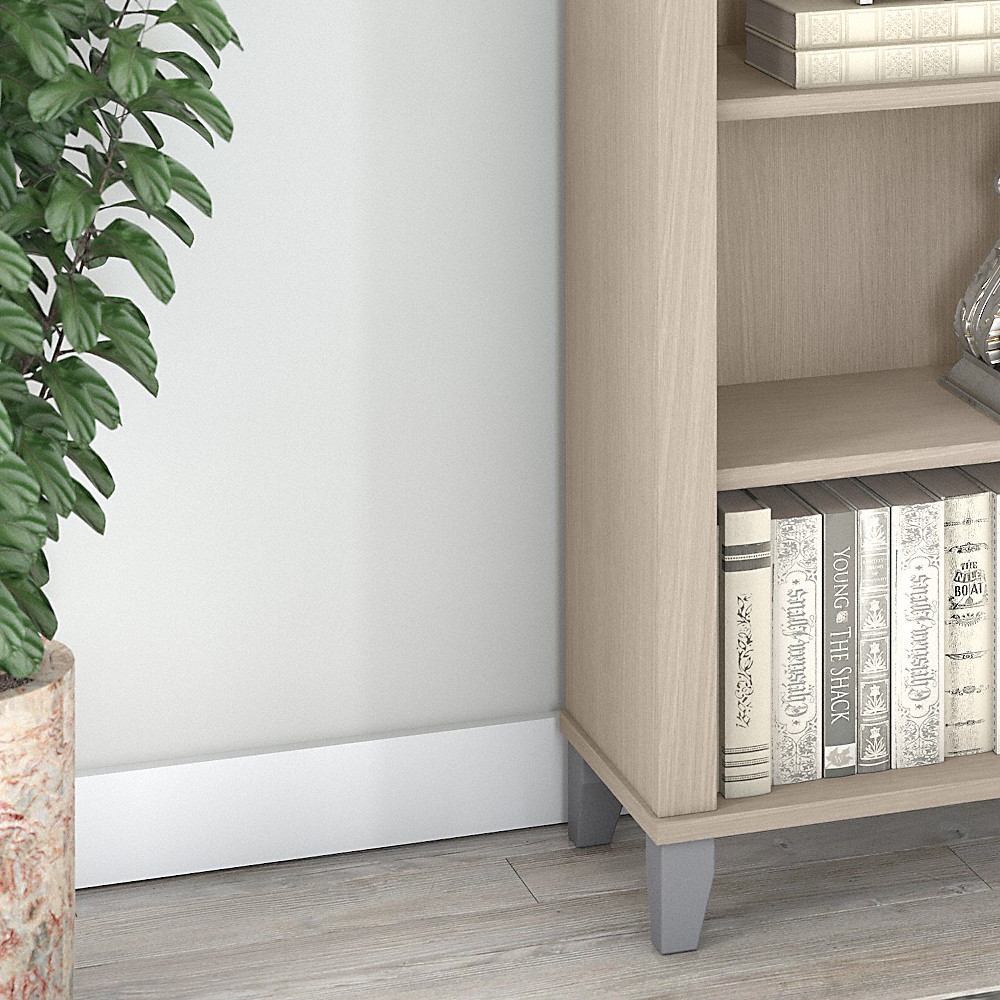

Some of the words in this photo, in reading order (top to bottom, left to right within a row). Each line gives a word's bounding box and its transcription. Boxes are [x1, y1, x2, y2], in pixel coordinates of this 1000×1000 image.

[832, 546, 851, 610] YOUNG
[954, 582, 983, 597] BOAT
[960, 560, 978, 571] THE
[829, 626, 852, 663] THE
[904, 626, 937, 702] Christian
[782, 641, 814, 718] Christian
[829, 666, 852, 725] SHACK
